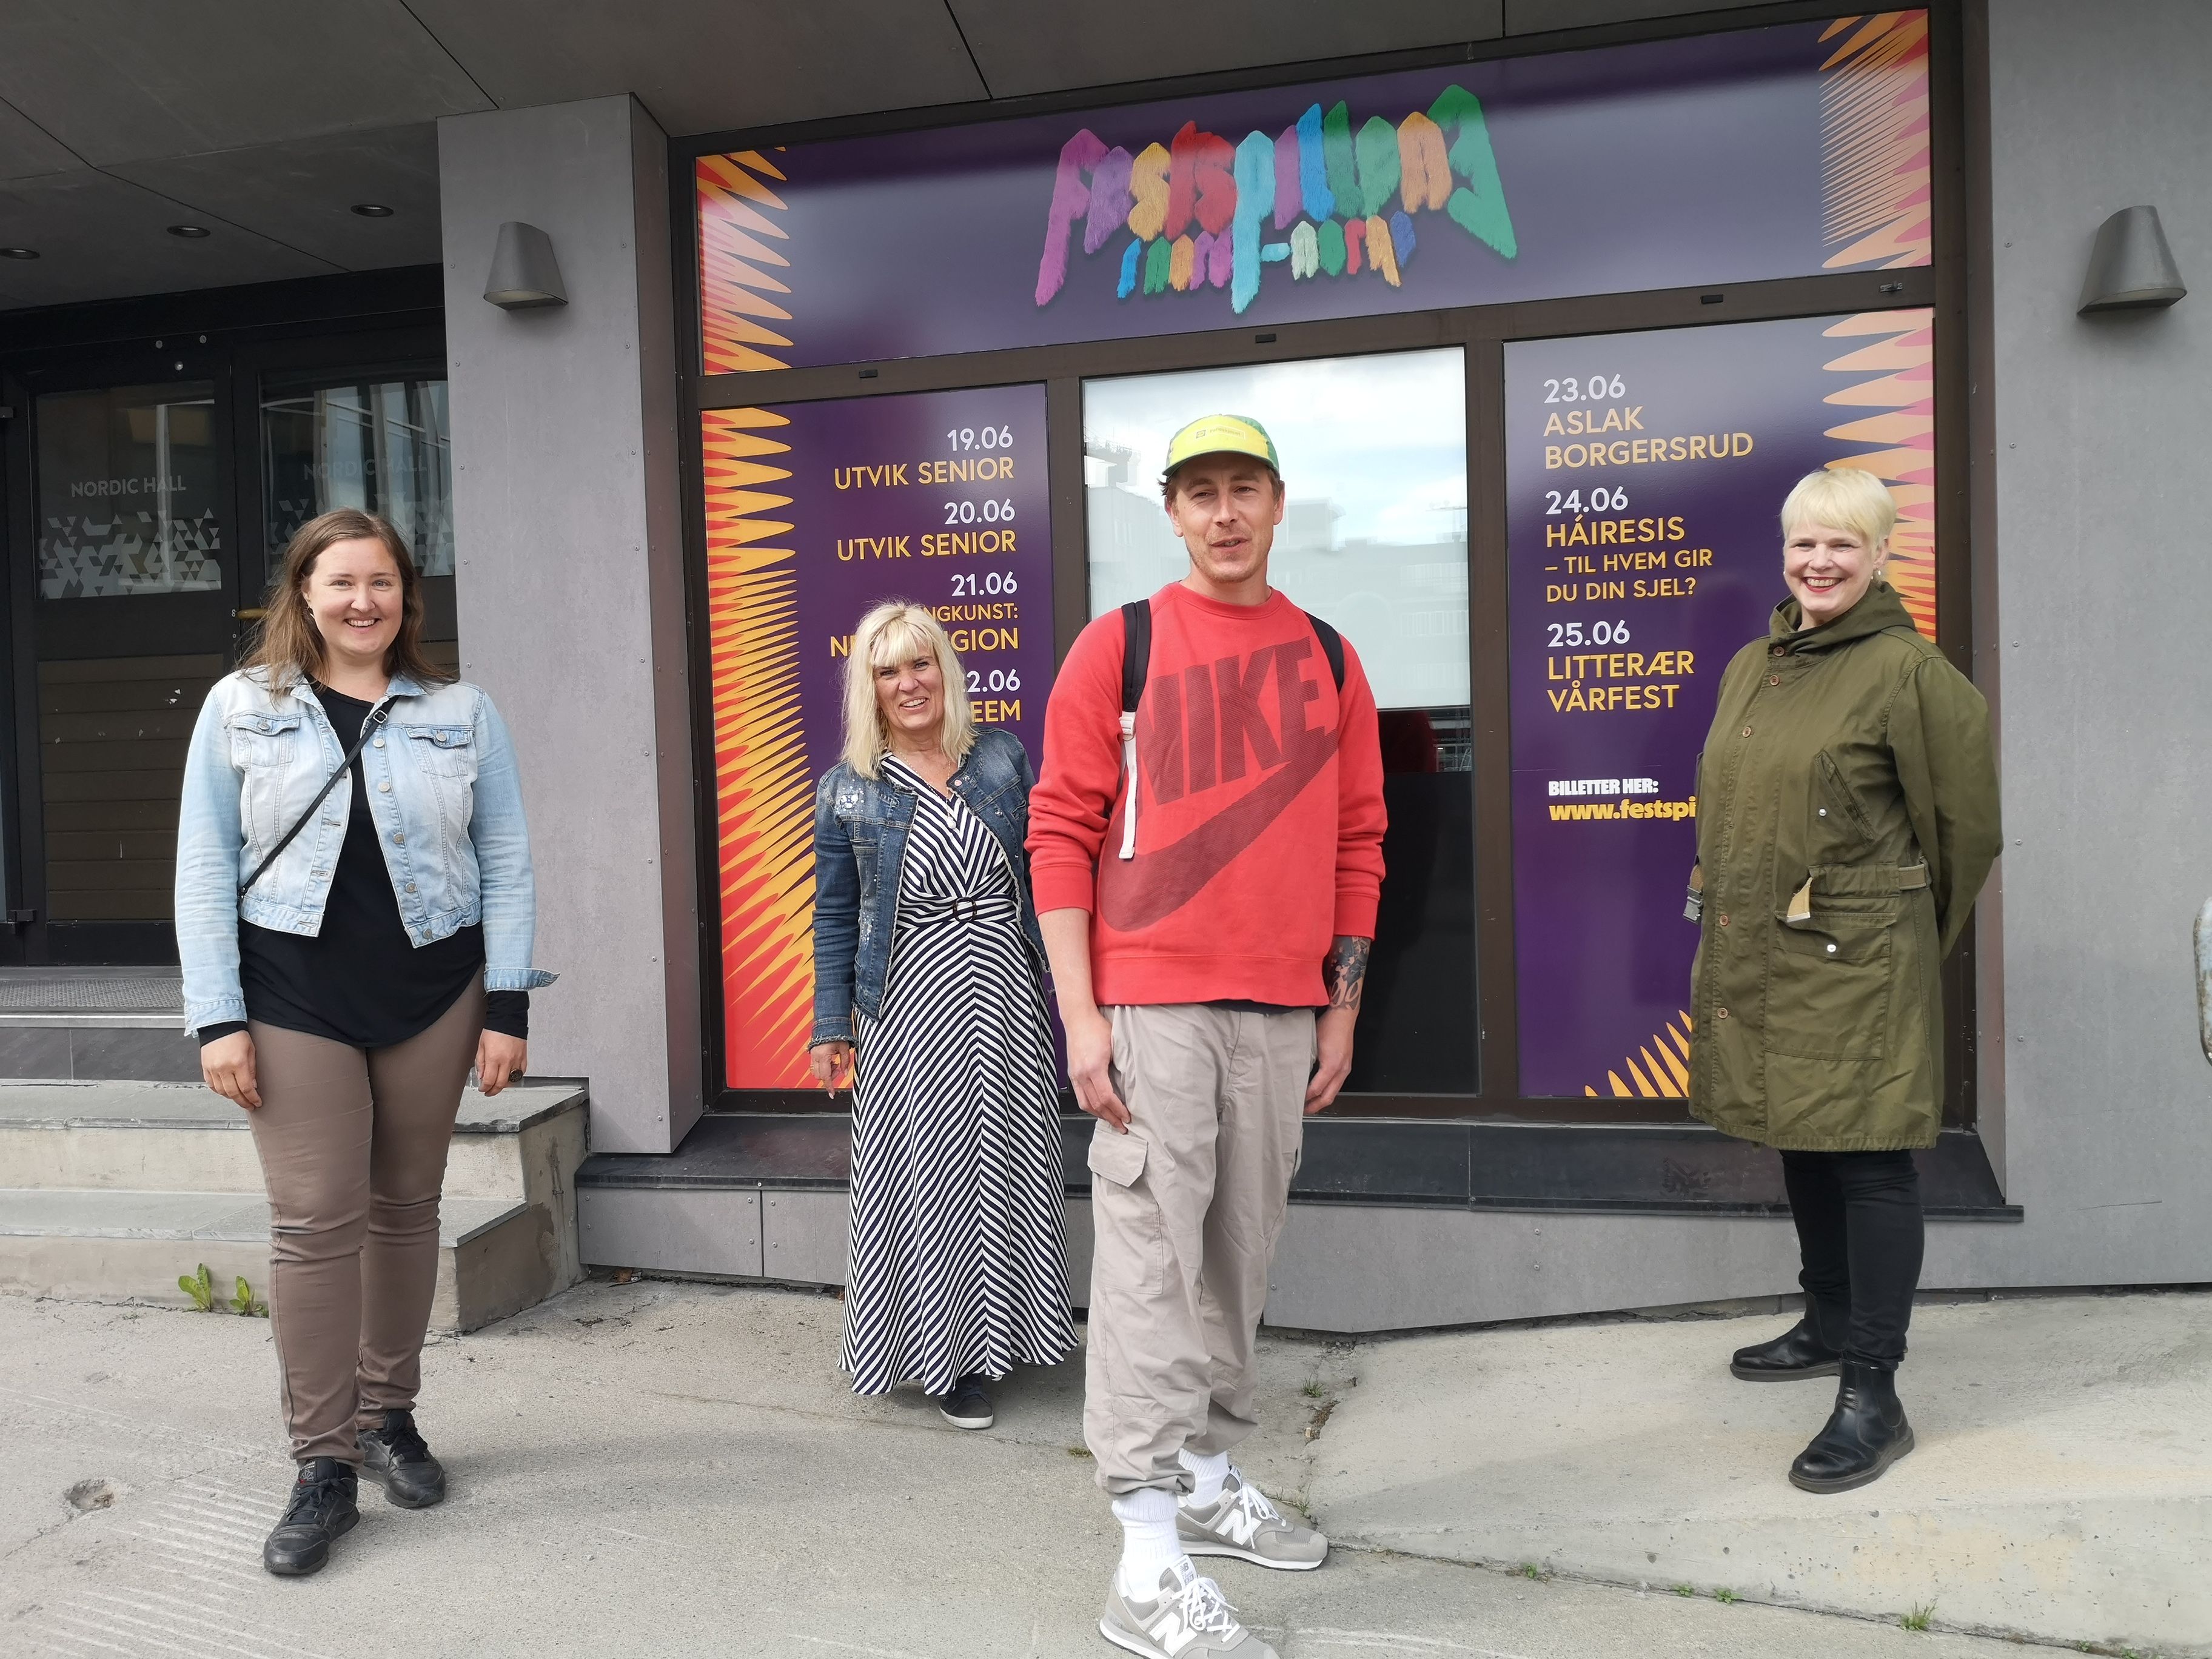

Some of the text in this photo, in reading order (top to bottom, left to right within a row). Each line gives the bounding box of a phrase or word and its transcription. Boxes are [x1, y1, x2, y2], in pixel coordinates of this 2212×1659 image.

[1543, 374, 1626, 403] 23.06
[1543, 406, 1644, 436] ASLAK
[947, 425, 1013, 451] 19.06
[1545, 433, 1754, 469] BORGERSRUD
[72, 475, 187, 497] NORDIC HALL
[834, 457, 1014, 489] UTVIK SENIOR
[944, 498, 1015, 525] 20.06
[1545, 486, 1629, 515] 24.06
[1546, 514, 1685, 548] HÁIRESIS
[837, 530, 1016, 561] UTVIK SENIOR
[1564, 557, 1596, 574] TIL
[1603, 552, 1667, 572] HVEM
[1674, 549, 1713, 568] GIR
[951, 571, 1017, 597] 21.06
[1546, 577, 1697, 602] DU DIN SJEL?
[923, 603, 1018, 622] NGKUNST:
[1547, 620, 1631, 647] 25.06
[1547, 651, 1695, 680] LITTERÆR
[964, 668, 1021, 692] 2.06
[1547, 680, 1680, 712] VÅRFEST
[970, 699, 1021, 722] EEM
[1135, 636, 1328, 818] NIKE
[1548, 778, 1659, 796] BILLETTER HER:
[1549, 796, 1697, 822] www.festspi
